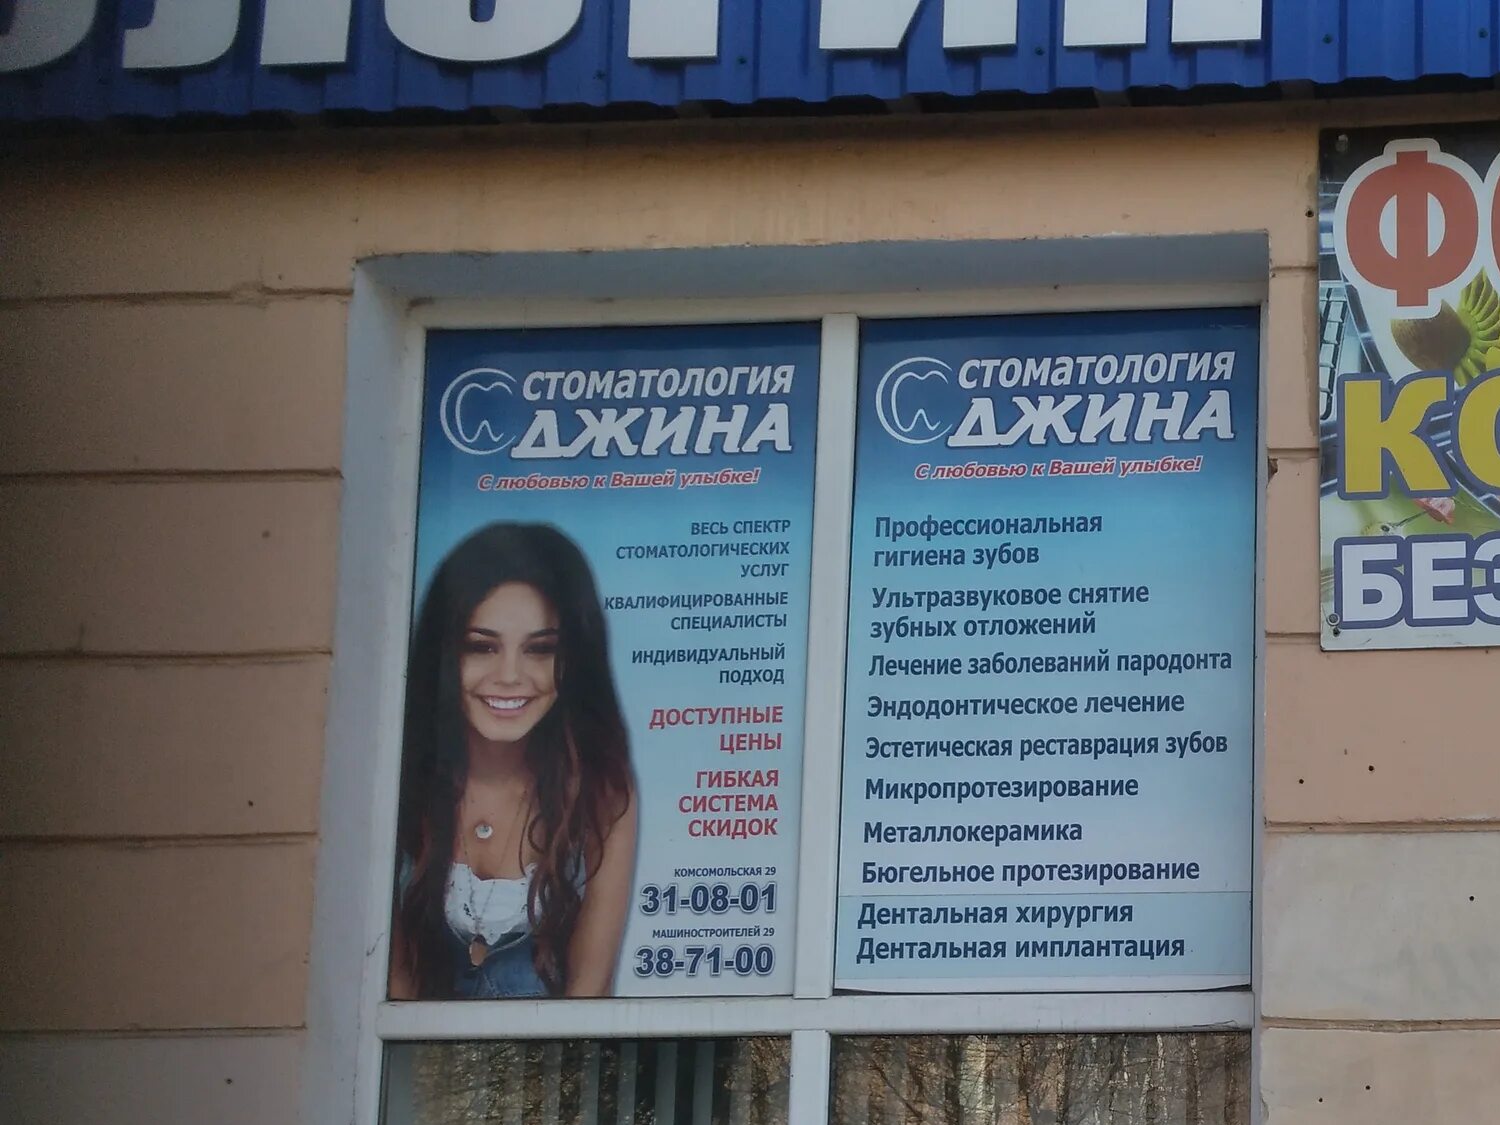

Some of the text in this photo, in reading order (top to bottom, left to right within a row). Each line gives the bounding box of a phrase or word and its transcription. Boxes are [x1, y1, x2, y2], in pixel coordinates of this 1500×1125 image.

[522, 365, 795, 401] СТОМАТОЛОГИЯ
[957, 351, 1236, 389] СТОМАТОЛОГИЯ
[510, 403, 793, 459] ДЖИНА
[946, 389, 1235, 448] ДЖИНА
[477, 467, 761, 490] С любовью к Вашей улыбке!
[913, 455, 1203, 480] С любовью к Вашей улыбке!
[691, 519, 791, 535] ВЕСЬ СПЕКТР
[874, 513, 1103, 541] Профессиональная
[616, 541, 790, 560] СТОМАТОЛОГИЧЕСКИХ
[873, 542, 1040, 570] гигиена зубов
[740, 563, 789, 578] УСЛУГ
[603, 591, 788, 610] КВАЛИФИЦИРОВАННЫЕ
[872, 583, 1150, 612] Ультразвуковое снятие
[670, 613, 787, 632] СПЕЦИАЛИСТЫ
[870, 611, 1096, 643] зубных отложений
[632, 642, 785, 666] ИНДИВИДУАЛЬНЫЙ
[868, 649, 1233, 676] Лечение заболеваний пародонта
[719, 668, 784, 686] ПОДХОД
[649, 706, 783, 729] ДОСТУПНЫЕ
[867, 692, 1185, 720] Эндодонтическое лечение
[720, 732, 782, 755] ЦЕНЫ
[865, 731, 1229, 761] Эстетическая реставрация зубов
[696, 769, 779, 789] ГИБКАЯ
[865, 775, 1139, 804] Микропротезирование
[678, 793, 779, 813] СИСТЕМА
[688, 817, 778, 839] СКИДОК
[863, 821, 1083, 847] Металлокерамика
[674, 866, 776, 878] КОМСОМОЛЬСКАЯ 29
[861, 859, 1200, 887] Бюгельное протезирование
[640, 882, 777, 916] 31-08-01
[857, 902, 1134, 930] Дентальная хирургия
[652, 925, 775, 939] МАШИНОСТРОИТЕЛЕЙ 29
[634, 944, 775, 978] 38-71-00
[856, 937, 1186, 964] Дентальная имплантация
